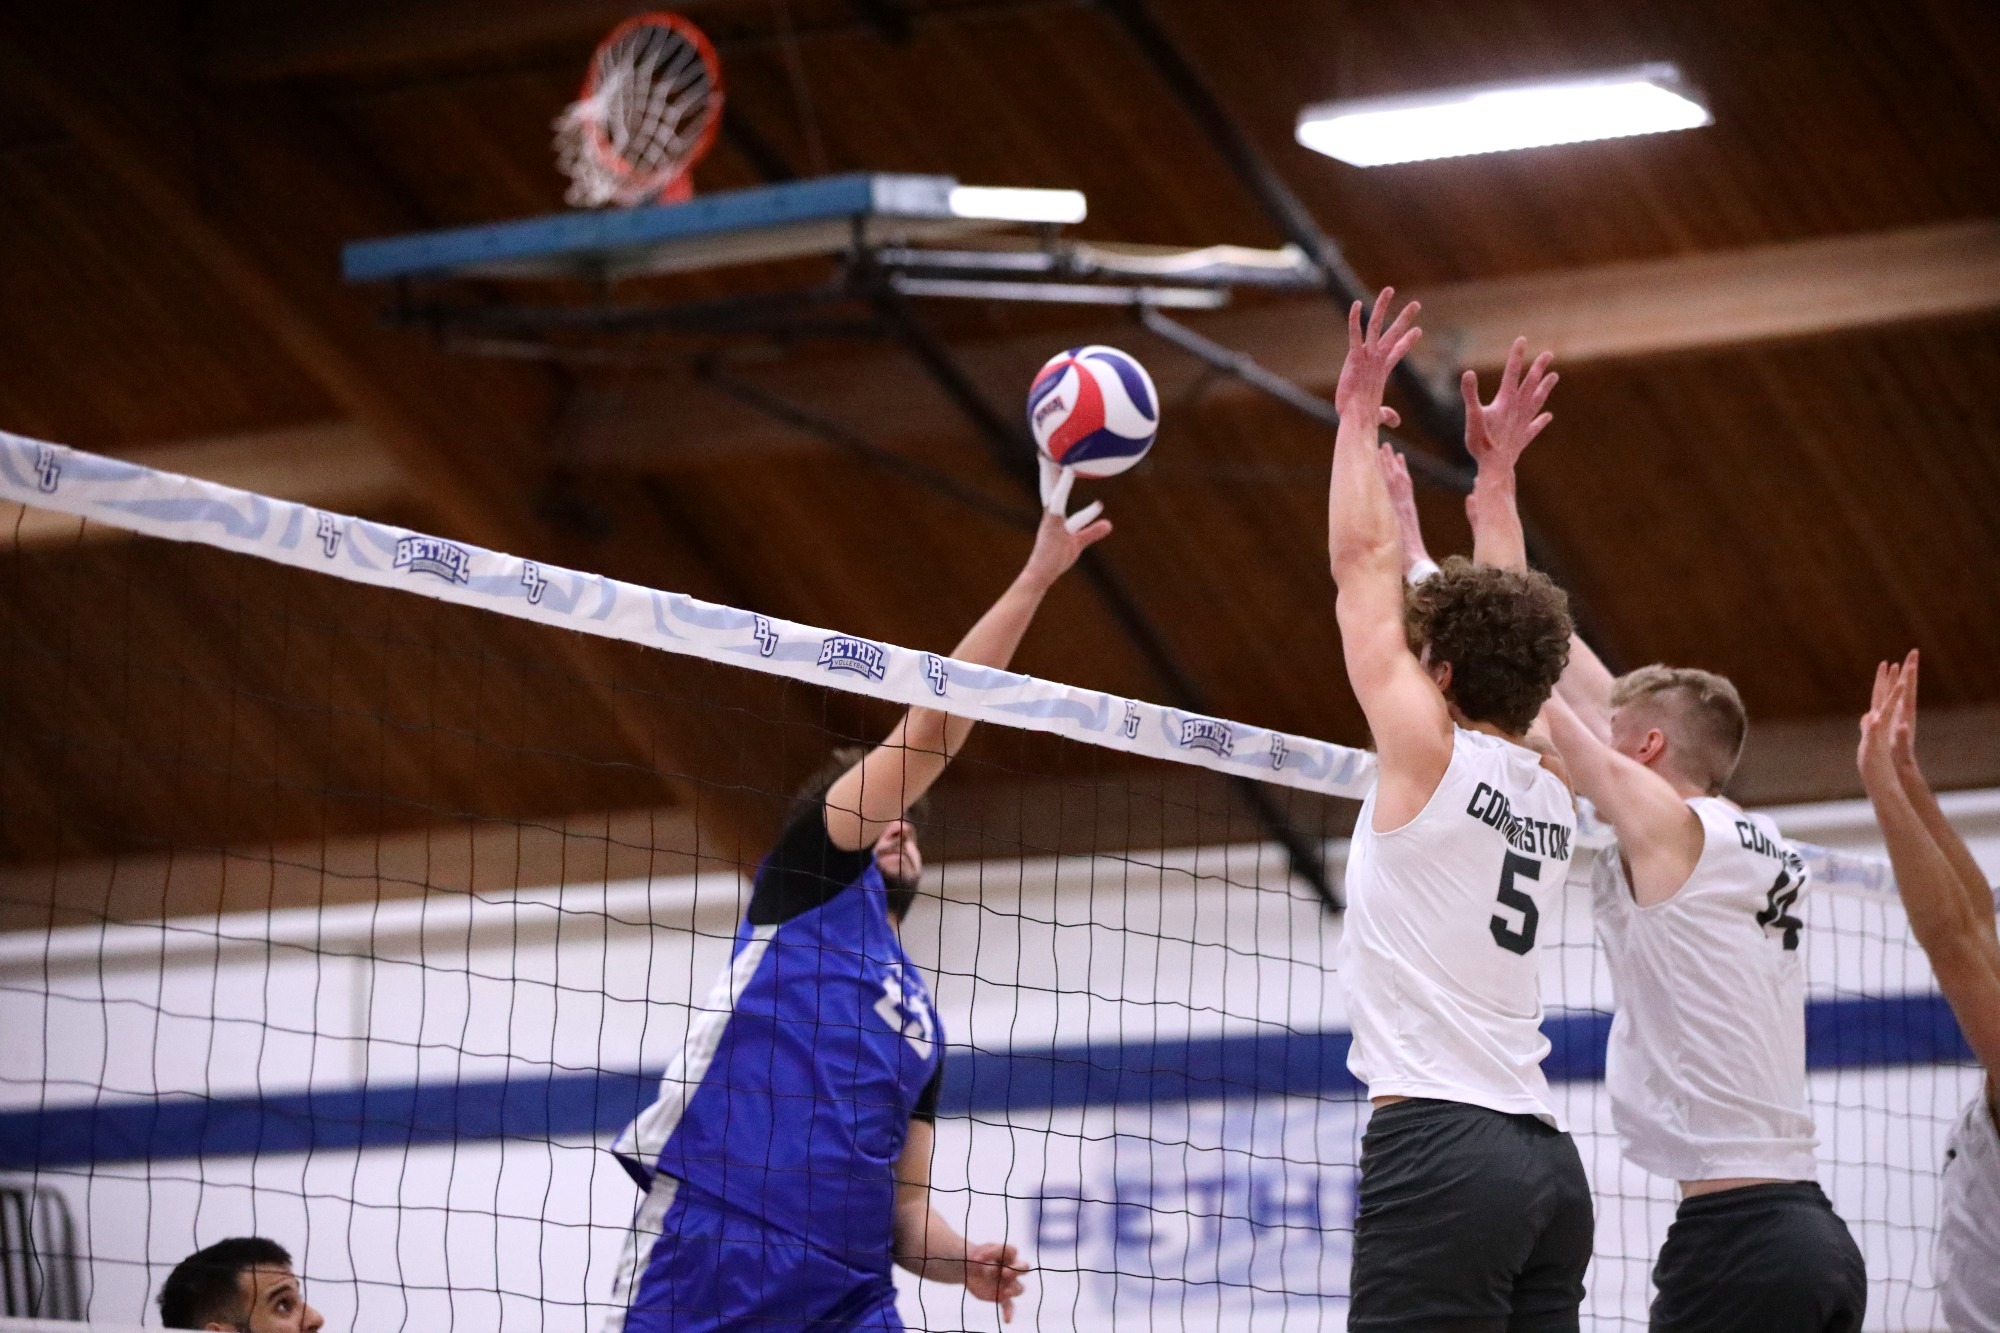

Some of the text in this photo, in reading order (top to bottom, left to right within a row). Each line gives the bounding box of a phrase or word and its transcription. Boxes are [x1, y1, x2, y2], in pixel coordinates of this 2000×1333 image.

[316, 511, 342, 558] BU
[393, 537, 469, 584] BETHEL
[521, 560, 547, 604] BU
[754, 615, 779, 658] BU
[817, 637, 885, 680] BETHEL
[834, 659, 868, 673] VOLLEYBALL
[928, 654, 948, 696] BU
[1180, 718, 1233, 757] BETHEL
[1489, 851, 1541, 956] 5
[1032, 1174, 1360, 1248] BETH
